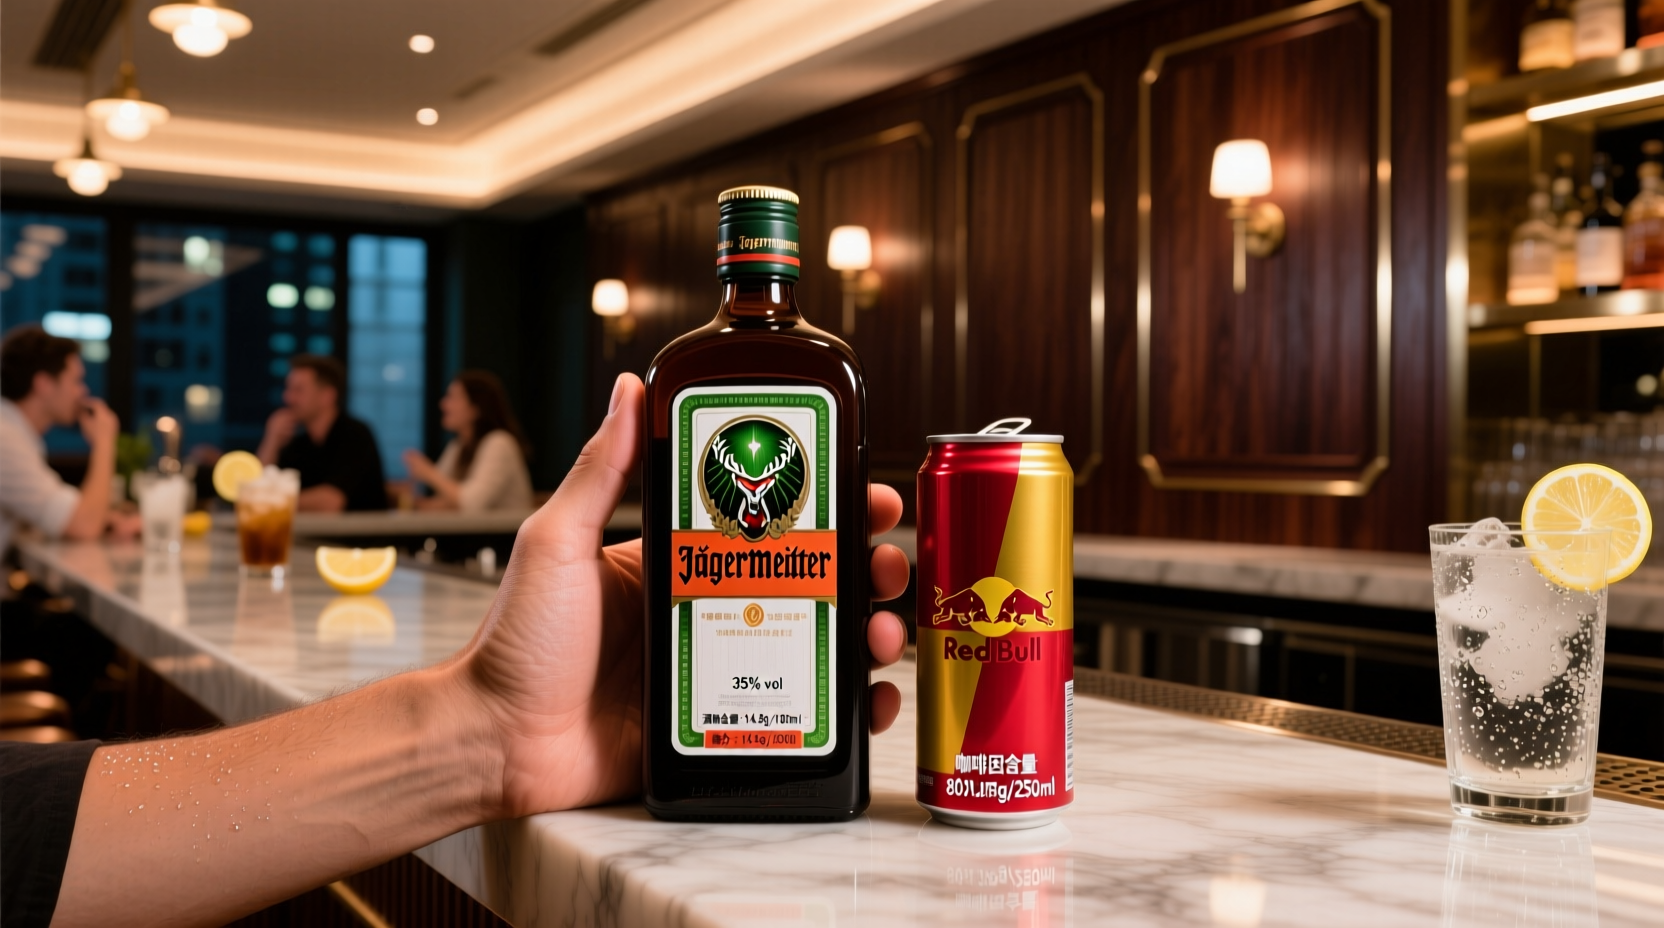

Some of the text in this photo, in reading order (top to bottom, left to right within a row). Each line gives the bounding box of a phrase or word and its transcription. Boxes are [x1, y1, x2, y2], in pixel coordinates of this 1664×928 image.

[943, 636, 1041, 662] Red Bull
[732, 676, 783, 690] 35% vol
